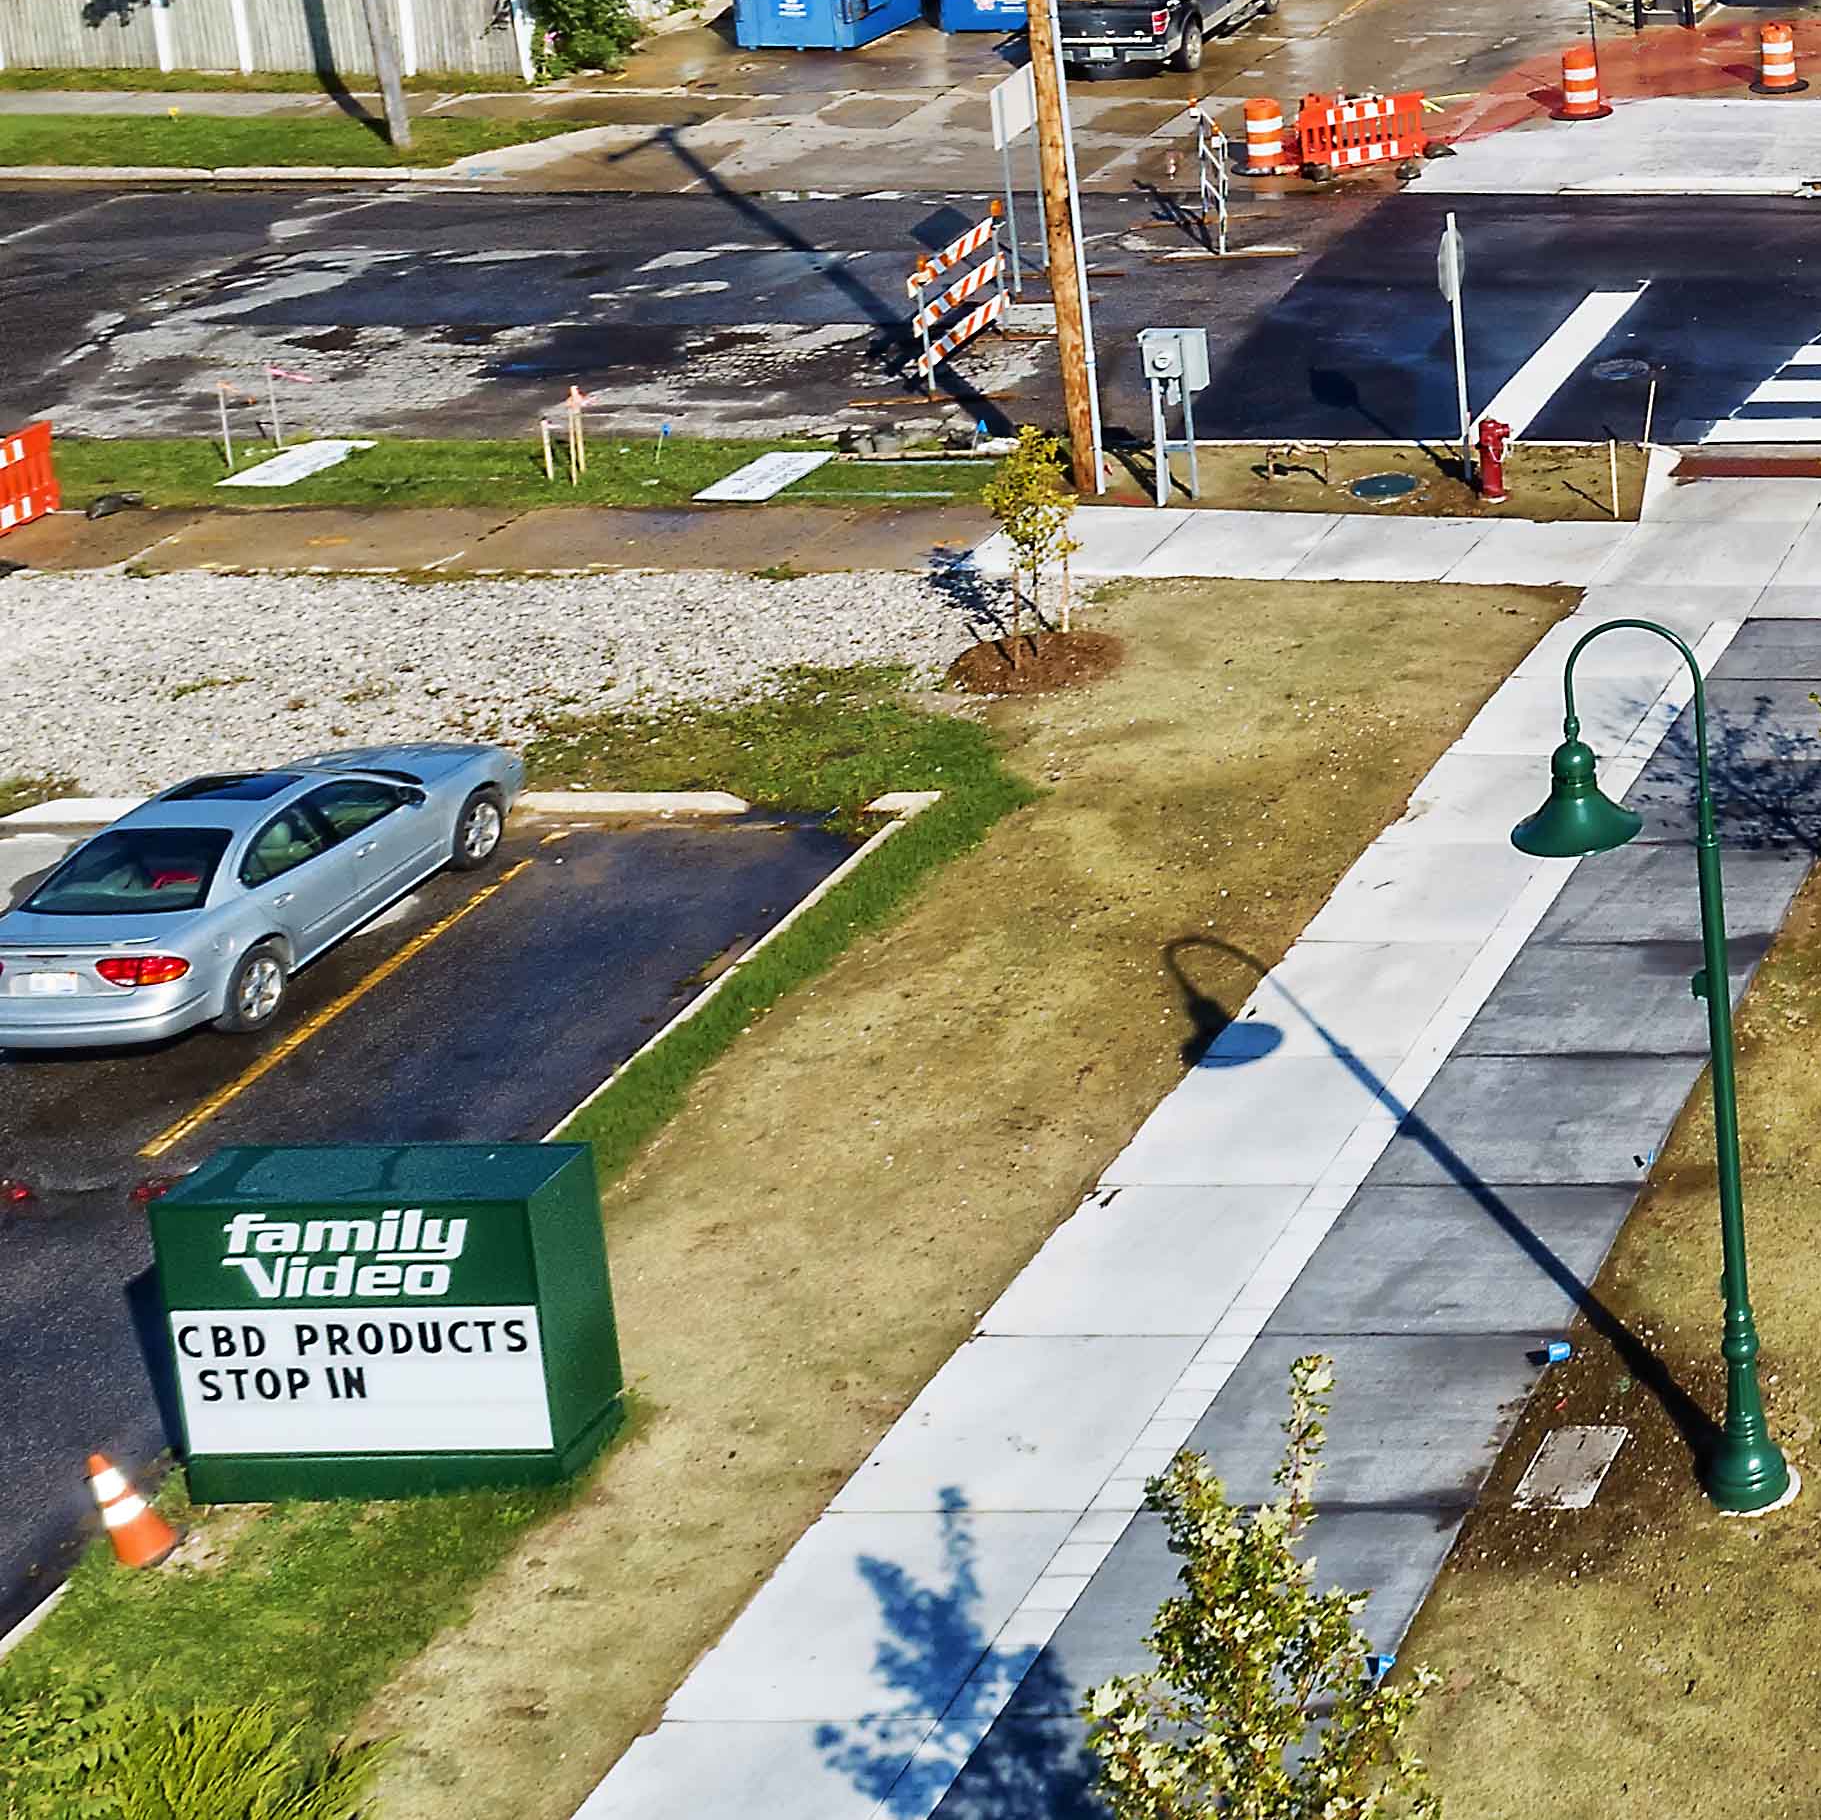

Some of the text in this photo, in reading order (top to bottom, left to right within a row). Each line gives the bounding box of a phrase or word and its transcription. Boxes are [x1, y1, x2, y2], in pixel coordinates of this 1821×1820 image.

[223, 1209, 469, 1261] family
[221, 1255, 451, 1299] Video
[178, 1319, 528, 1358] CBD PRODUCTS
[198, 1366, 368, 1402] STOP IN
